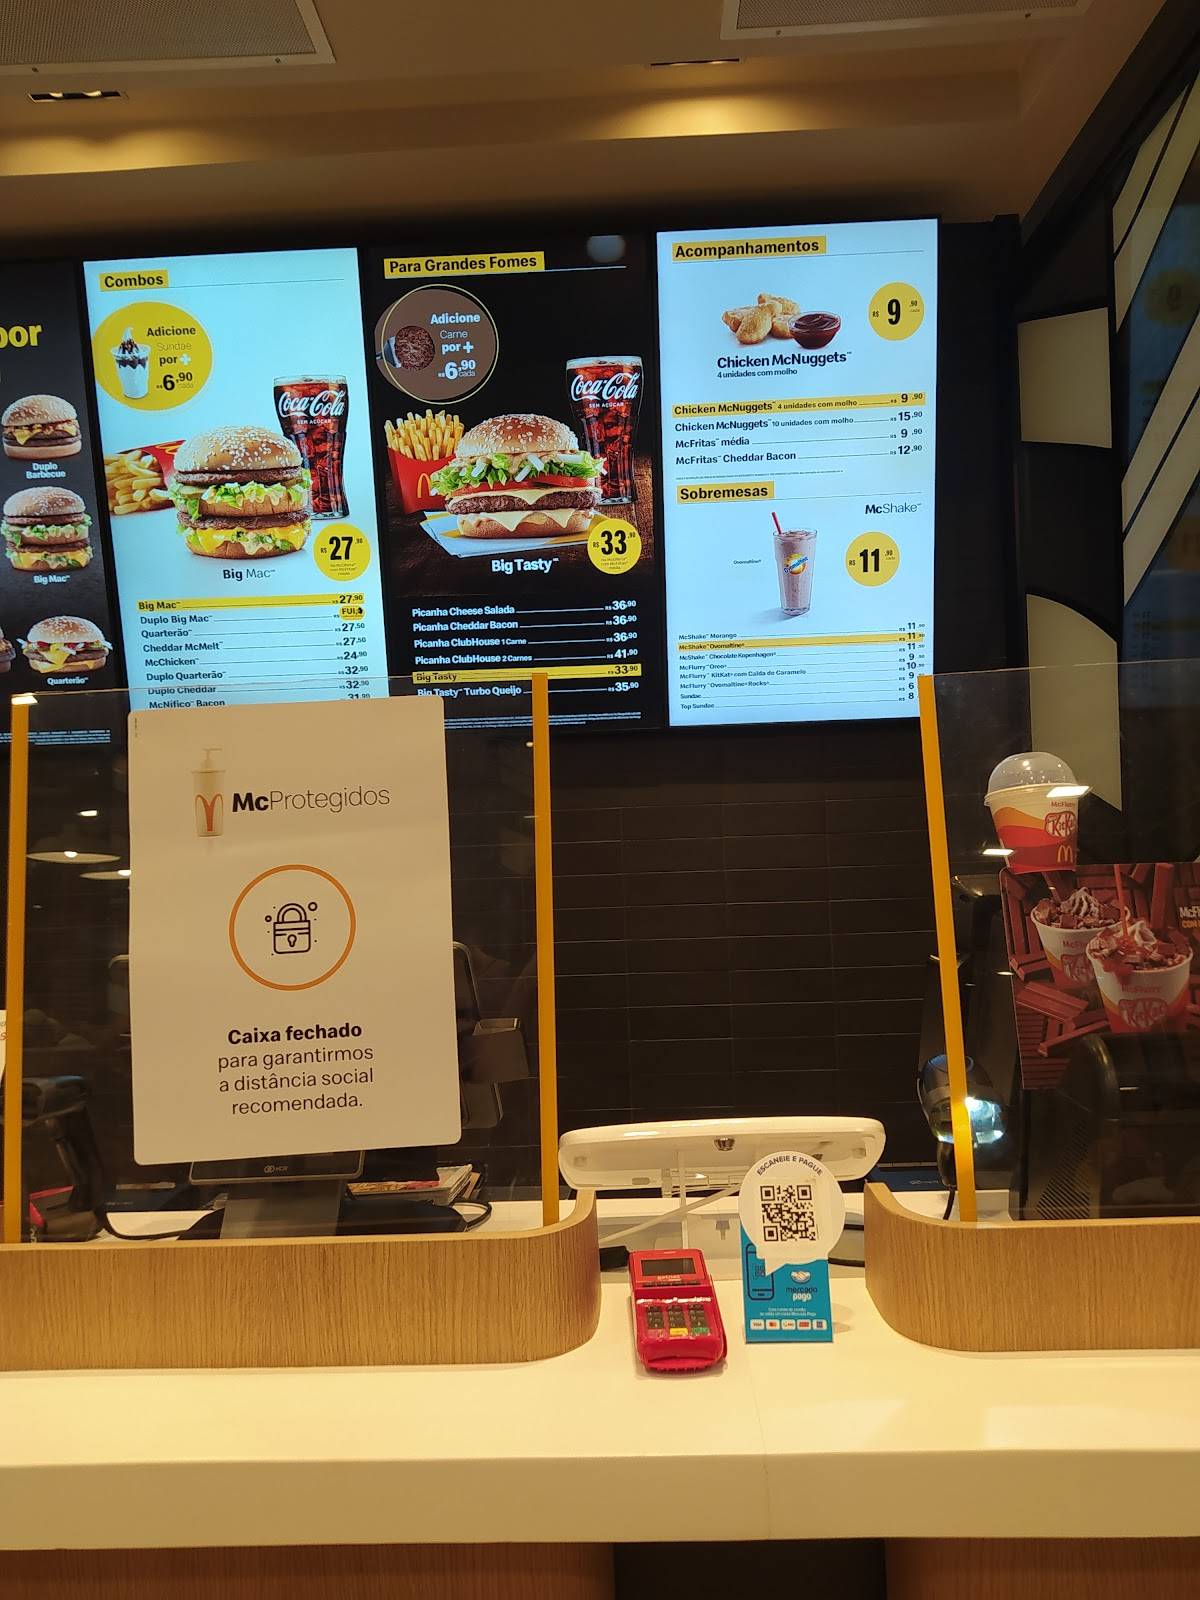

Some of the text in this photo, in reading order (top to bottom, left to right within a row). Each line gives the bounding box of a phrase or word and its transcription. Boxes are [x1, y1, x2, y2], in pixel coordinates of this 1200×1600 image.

[675, 240, 819, 259] Acompanhamentos
[390, 256, 537, 273] Para Grandes Fomes
[104, 275, 164, 288] Combos
[887, 298, 901, 325] 9
[430, 312, 481, 325] Adicione
[146, 326, 197, 337] Adicione
[439, 330, 468, 339] Carne
[156, 342, 192, 351] Sundae
[441, 343, 461, 354] por
[159, 355, 178, 366] por
[717, 352, 847, 369] Chicken McNuggets
[722, 370, 756, 378] unidades
[774, 368, 798, 376] molho
[571, 372, 641, 401] Coca-Cola
[278, 389, 346, 417] Coca-Cola
[674, 405, 716, 415] Chicken
[718, 402, 773, 413] McNuggets
[783, 401, 816, 409] unidades
[674, 421, 715, 431] Chicken
[716, 419, 769, 430] McNuggets
[830, 416, 854, 424] molho
[675, 436, 750, 448] McFritas média
[675, 455, 718, 465] McFritas
[723, 453, 764, 462] Cheddar
[766, 452, 796, 461] Bacon
[32, 462, 58, 471] Duplo
[26, 470, 66, 479] Barbecue
[680, 487, 768, 500] Sobremesas
[865, 502, 918, 514] McShake
[329, 536, 353, 560] 27
[601, 530, 627, 555] 33
[491, 558, 552, 574] Big Tasty
[859, 549, 881, 572] 11
[34, 576, 49, 585] Big
[222, 568, 272, 582] Big Mac
[138, 601, 154, 611] Big
[156, 601, 177, 609] Mac
[412, 608, 448, 617] Picanha
[449, 607, 483, 616] Cheese
[484, 605, 515, 614] Salada
[140, 615, 209, 626] Duplo Big Mac
[412, 622, 449, 632] Picanha
[450, 621, 489, 630] Cheddar
[490, 620, 518, 629] Bacon
[141, 629, 189, 639] Quarterão
[143, 643, 183, 652] Cheddar
[184, 642, 220, 651] McMelt
[413, 639, 450, 648] Picanha
[451, 638, 500, 647] ClubHouse
[145, 658, 196, 667] McChicken
[414, 655, 451, 665] Picanha
[451, 654, 501, 664] ClubHouse
[146, 672, 174, 682] Duplo
[175, 670, 223, 681] Quarterão
[416, 673, 431, 682] Big
[432, 672, 457, 682] Tasty
[148, 687, 175, 696] Duplo
[177, 686, 216, 694] Cheddar
[433, 688, 459, 698] Tasty
[463, 687, 491, 696] Turbo
[491, 685, 522, 696] Queijo
[196, 699, 226, 707] Bacon
[232, 786, 391, 813] McProtegidos
[227, 1022, 362, 1045] Caixa fechado
[218, 1047, 374, 1073] para garantirmos
[219, 1067, 374, 1092] a distância social
[232, 1092, 363, 1115] recomendada.
[756, 1154, 791, 1176] ESCANEIE
[798, 1156, 824, 1177] PAGUE
[793, 1293, 812, 1303] pago
